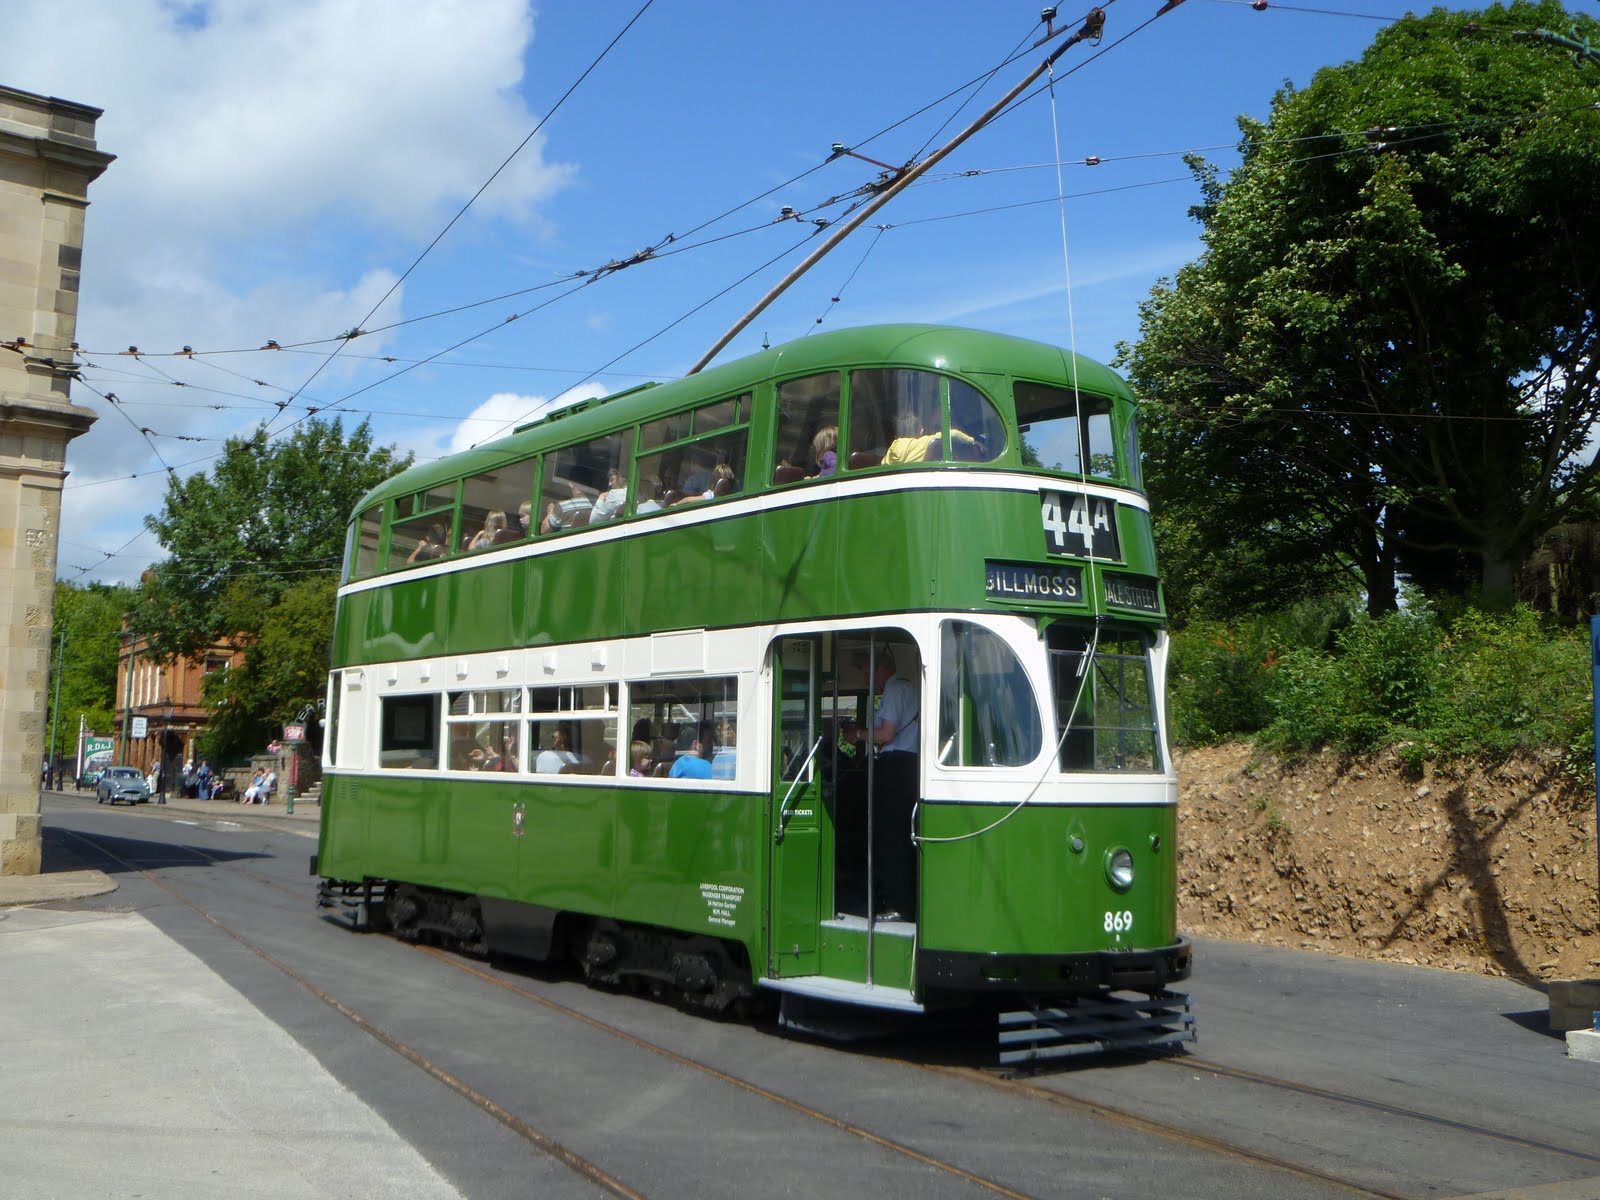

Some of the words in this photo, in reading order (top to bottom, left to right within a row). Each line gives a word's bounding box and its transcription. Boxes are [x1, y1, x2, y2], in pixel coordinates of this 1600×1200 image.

[1041, 492, 1109, 549] 44A
[1125, 586, 1158, 609] STREET
[700, 883, 718, 891] LIVERPOOL
[718, 885, 745, 895] CORPORATION
[702, 891, 721, 900] PASSENGER
[721, 893, 742, 902] TRANSPORT
[1104, 910, 1133, 932] 869
